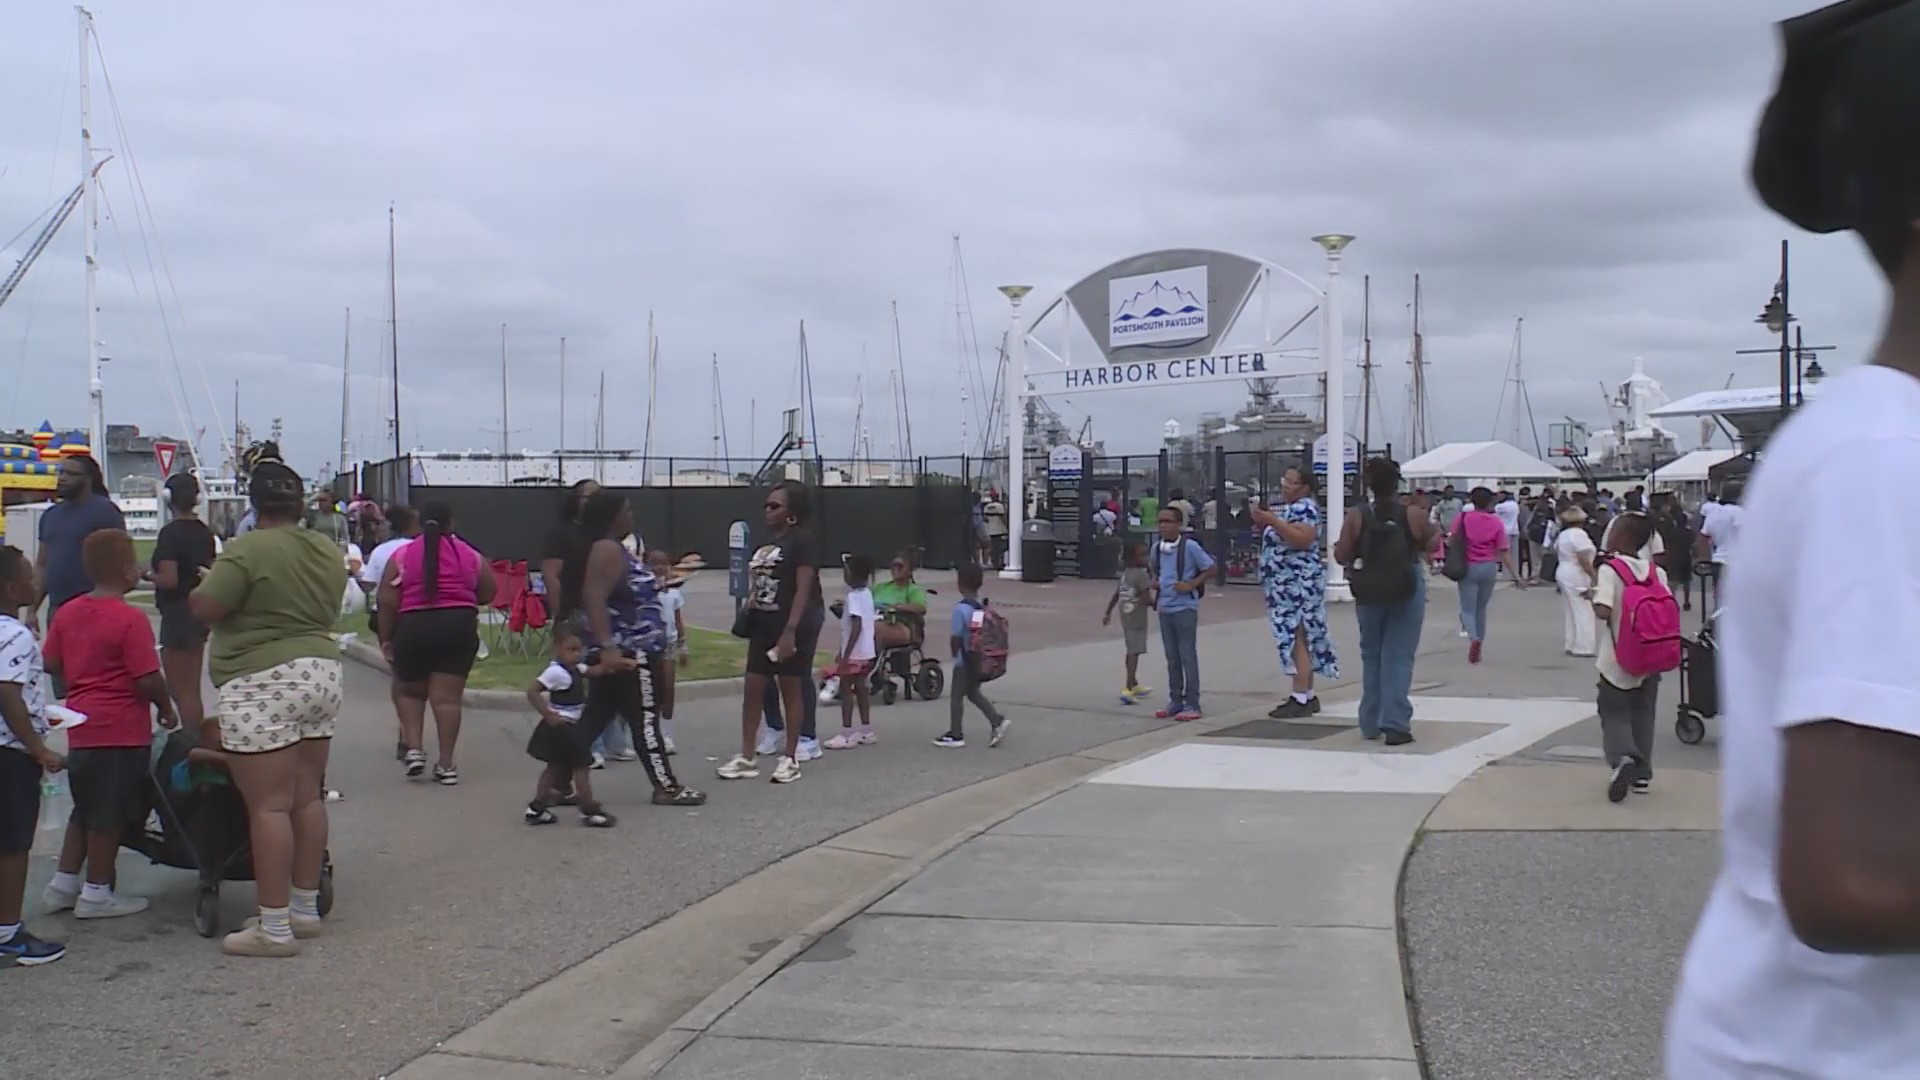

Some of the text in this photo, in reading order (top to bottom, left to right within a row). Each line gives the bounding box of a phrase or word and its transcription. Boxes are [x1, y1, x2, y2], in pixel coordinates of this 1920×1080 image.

[1113, 316, 1204, 334] PORTSMOUTH PAVILION
[1066, 352, 1266, 388] HARBOR CENTER
